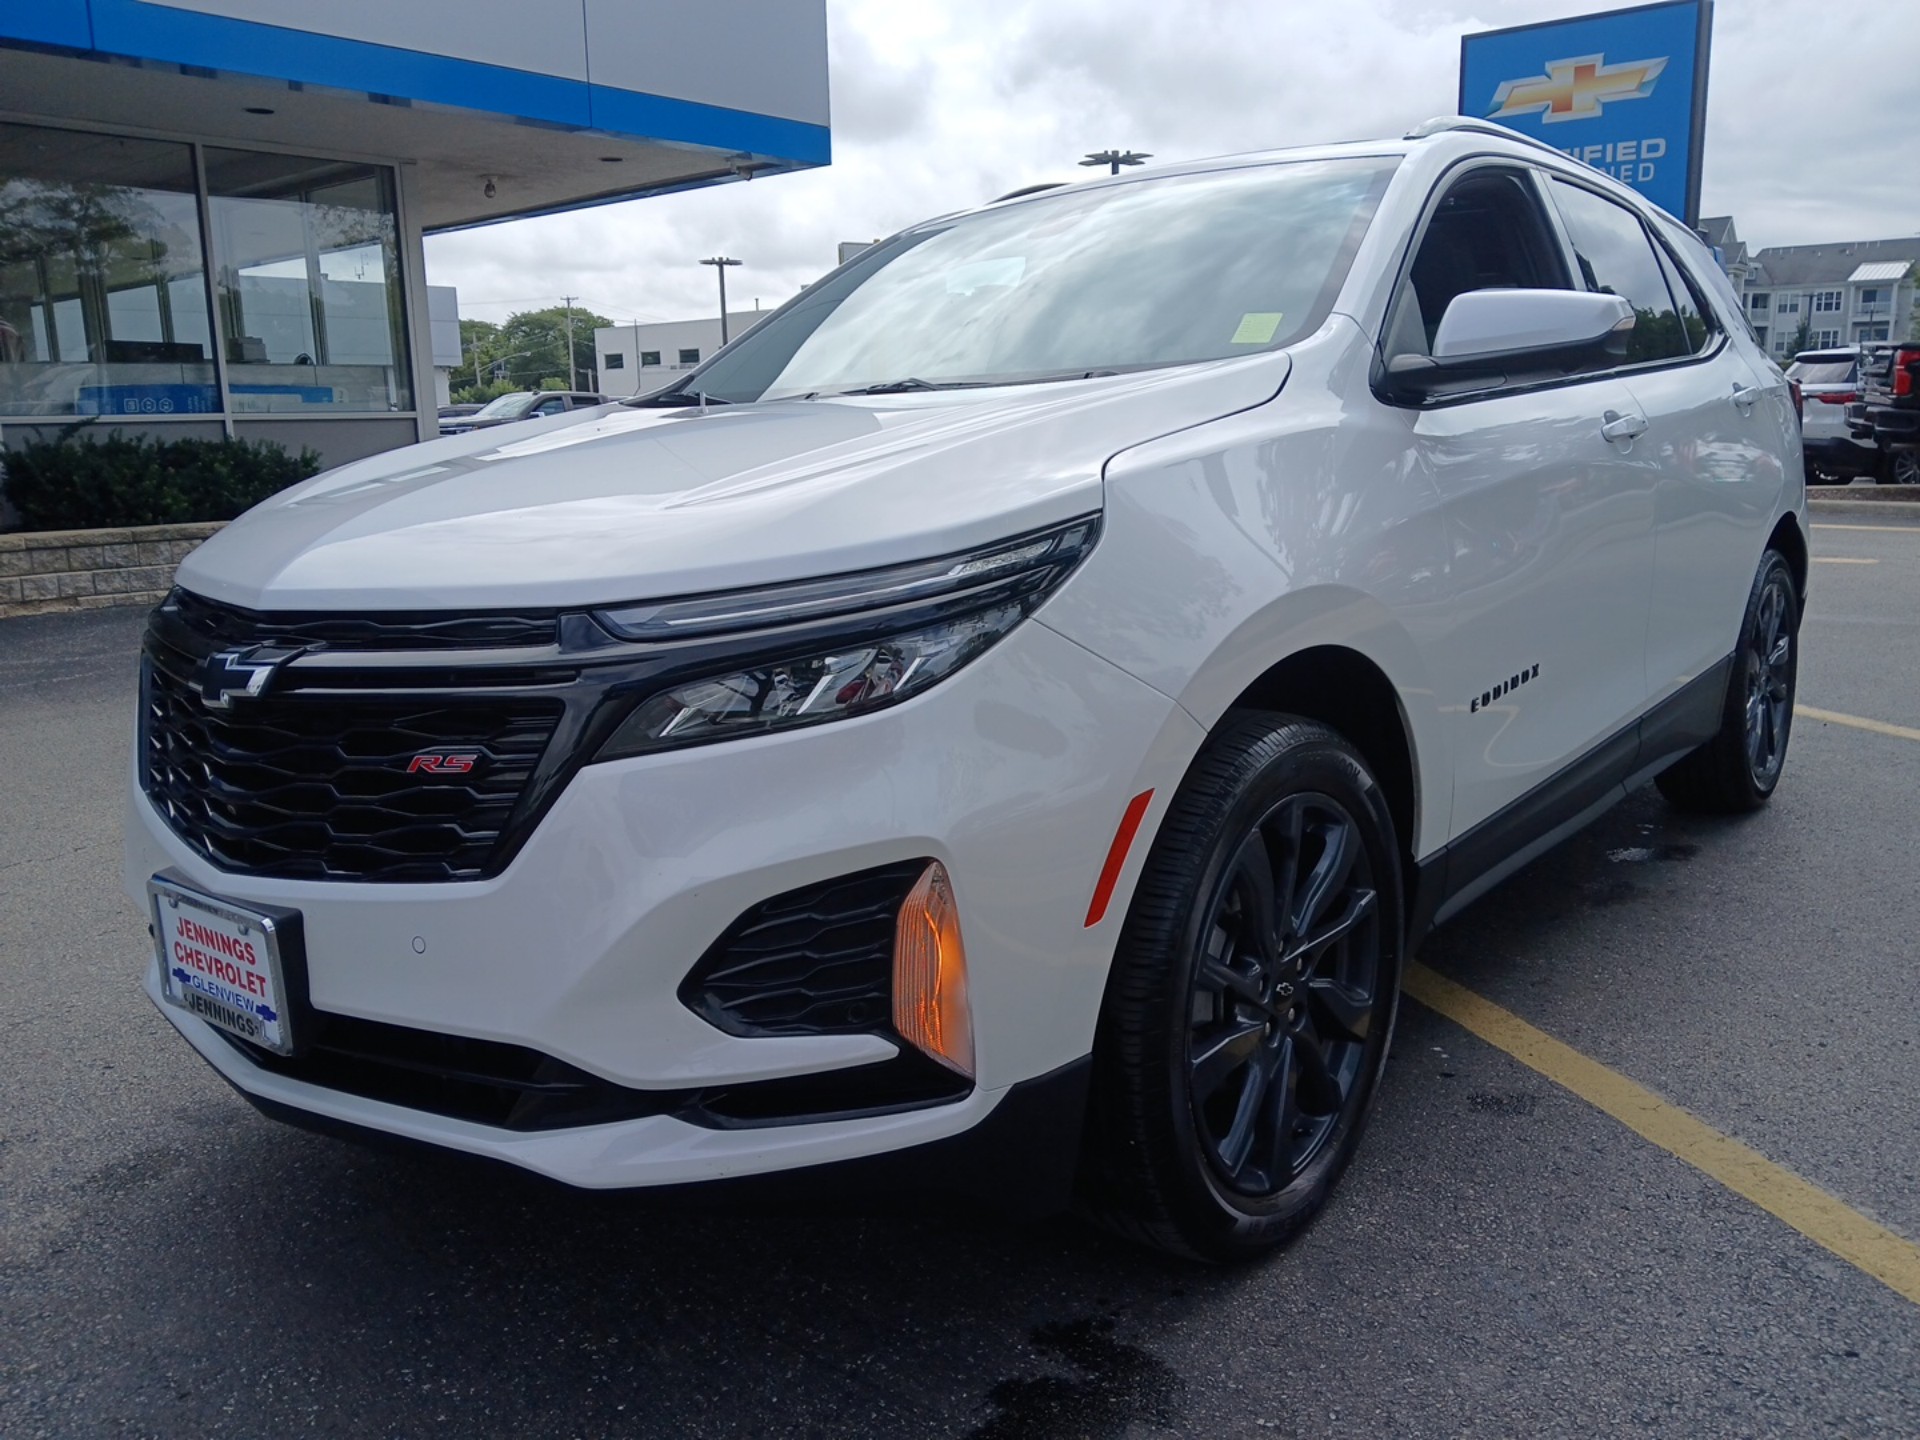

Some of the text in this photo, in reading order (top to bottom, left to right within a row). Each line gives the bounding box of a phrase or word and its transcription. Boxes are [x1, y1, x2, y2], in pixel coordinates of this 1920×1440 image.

[1470, 663, 1540, 713] EQUINOX
[406, 754, 478, 773] RS
[176, 917, 256, 966] JENNINGS
[174, 941, 267, 998] CHEVROLET
[188, 993, 256, 1037] JENNINGS
[191, 975, 255, 1012] GLENVIEW
